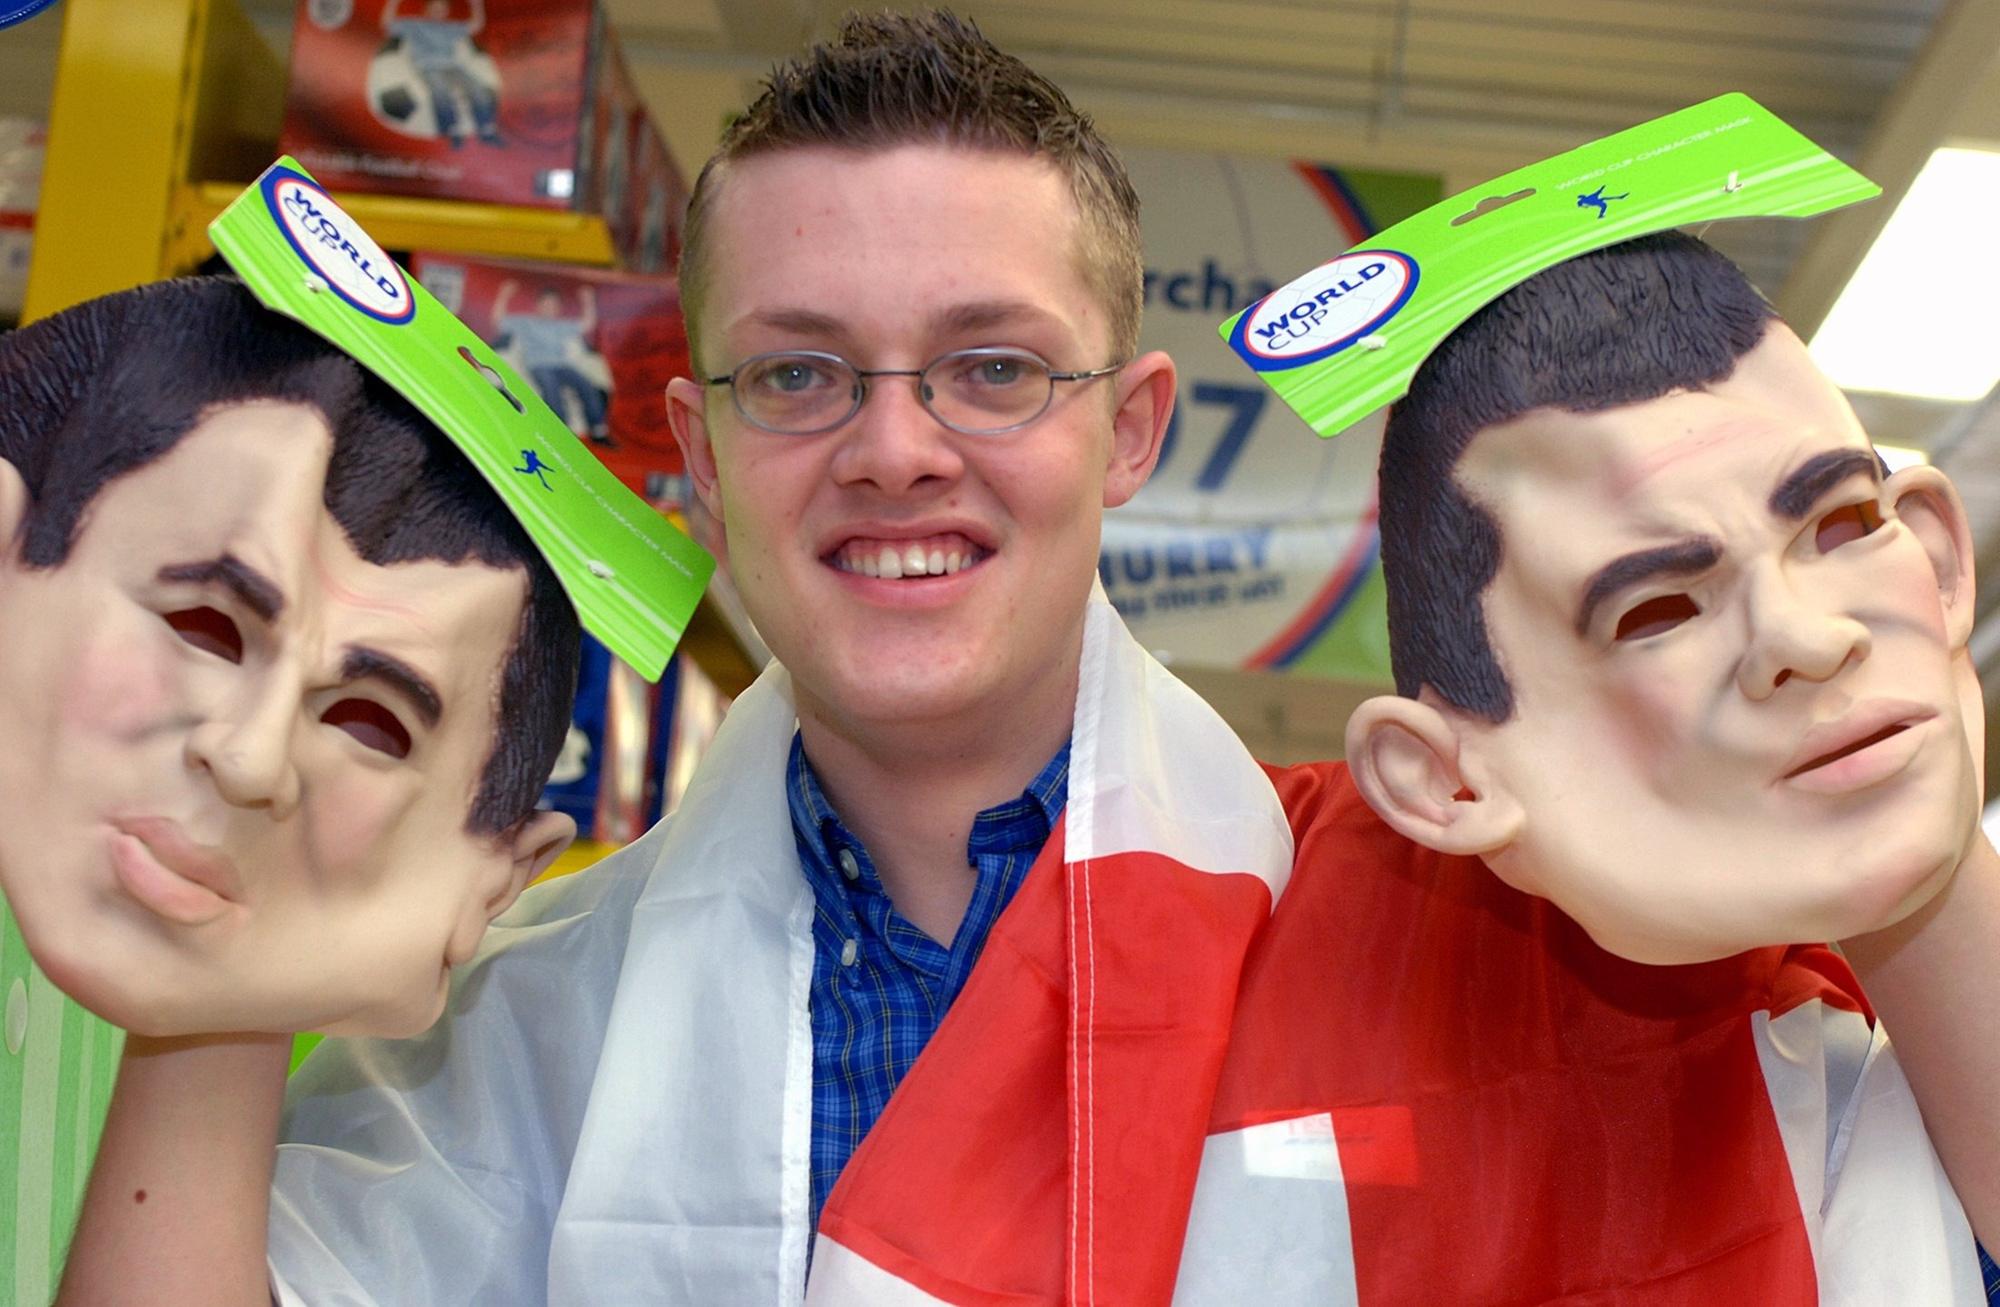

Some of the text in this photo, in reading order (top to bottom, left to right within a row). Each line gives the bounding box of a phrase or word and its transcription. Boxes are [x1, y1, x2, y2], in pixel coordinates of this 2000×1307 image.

[1554, 167, 1606, 190] WORLD
[1606, 158, 1633, 173] CUP
[284, 197, 337, 250] CUP
[295, 188, 399, 298] WORLD
[1255, 263, 1386, 338] WORLD
[1267, 308, 1328, 350] CUP
